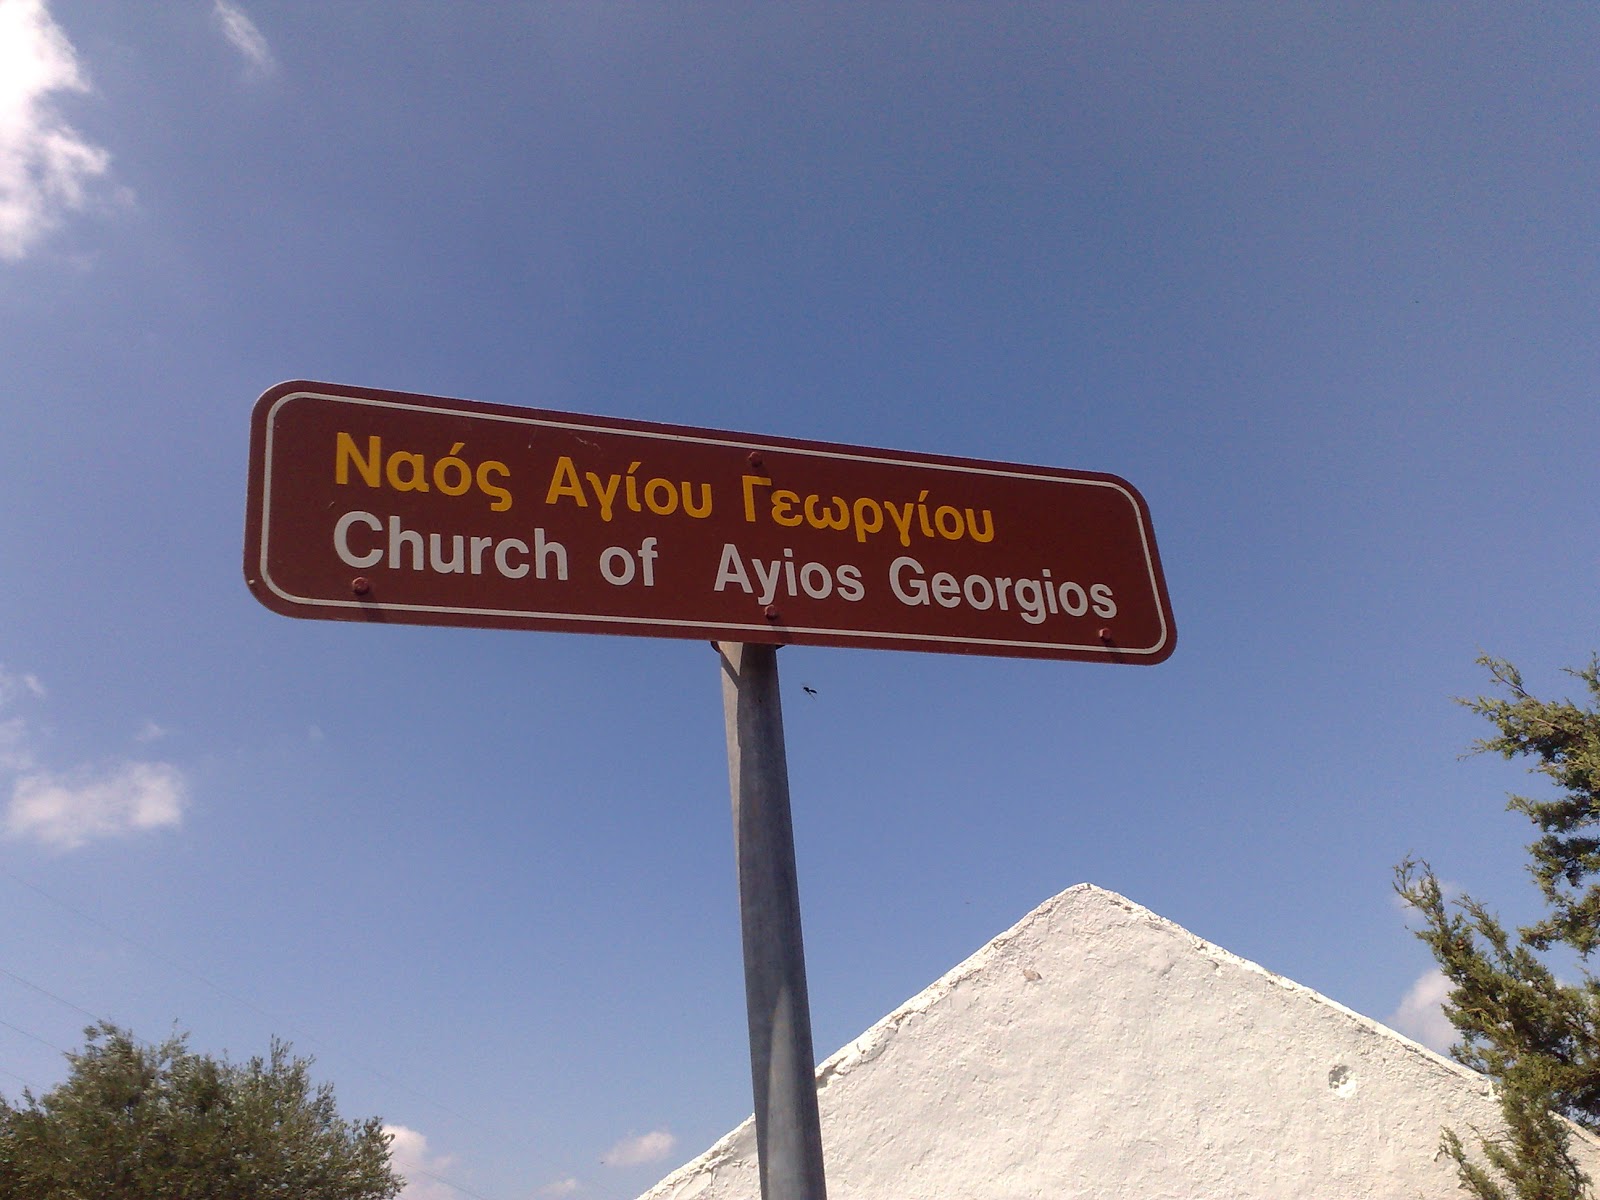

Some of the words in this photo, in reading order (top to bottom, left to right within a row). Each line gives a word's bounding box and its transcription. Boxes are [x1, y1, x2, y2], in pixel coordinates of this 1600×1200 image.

[336, 432, 513, 512] Ναός
[545, 456, 713, 522] Αγίου
[741, 475, 996, 547] Γεωργίου
[333, 510, 569, 581] Church
[599, 536, 659, 587] of
[713, 543, 866, 606] Ayios
[888, 556, 1119, 625] Georgios
